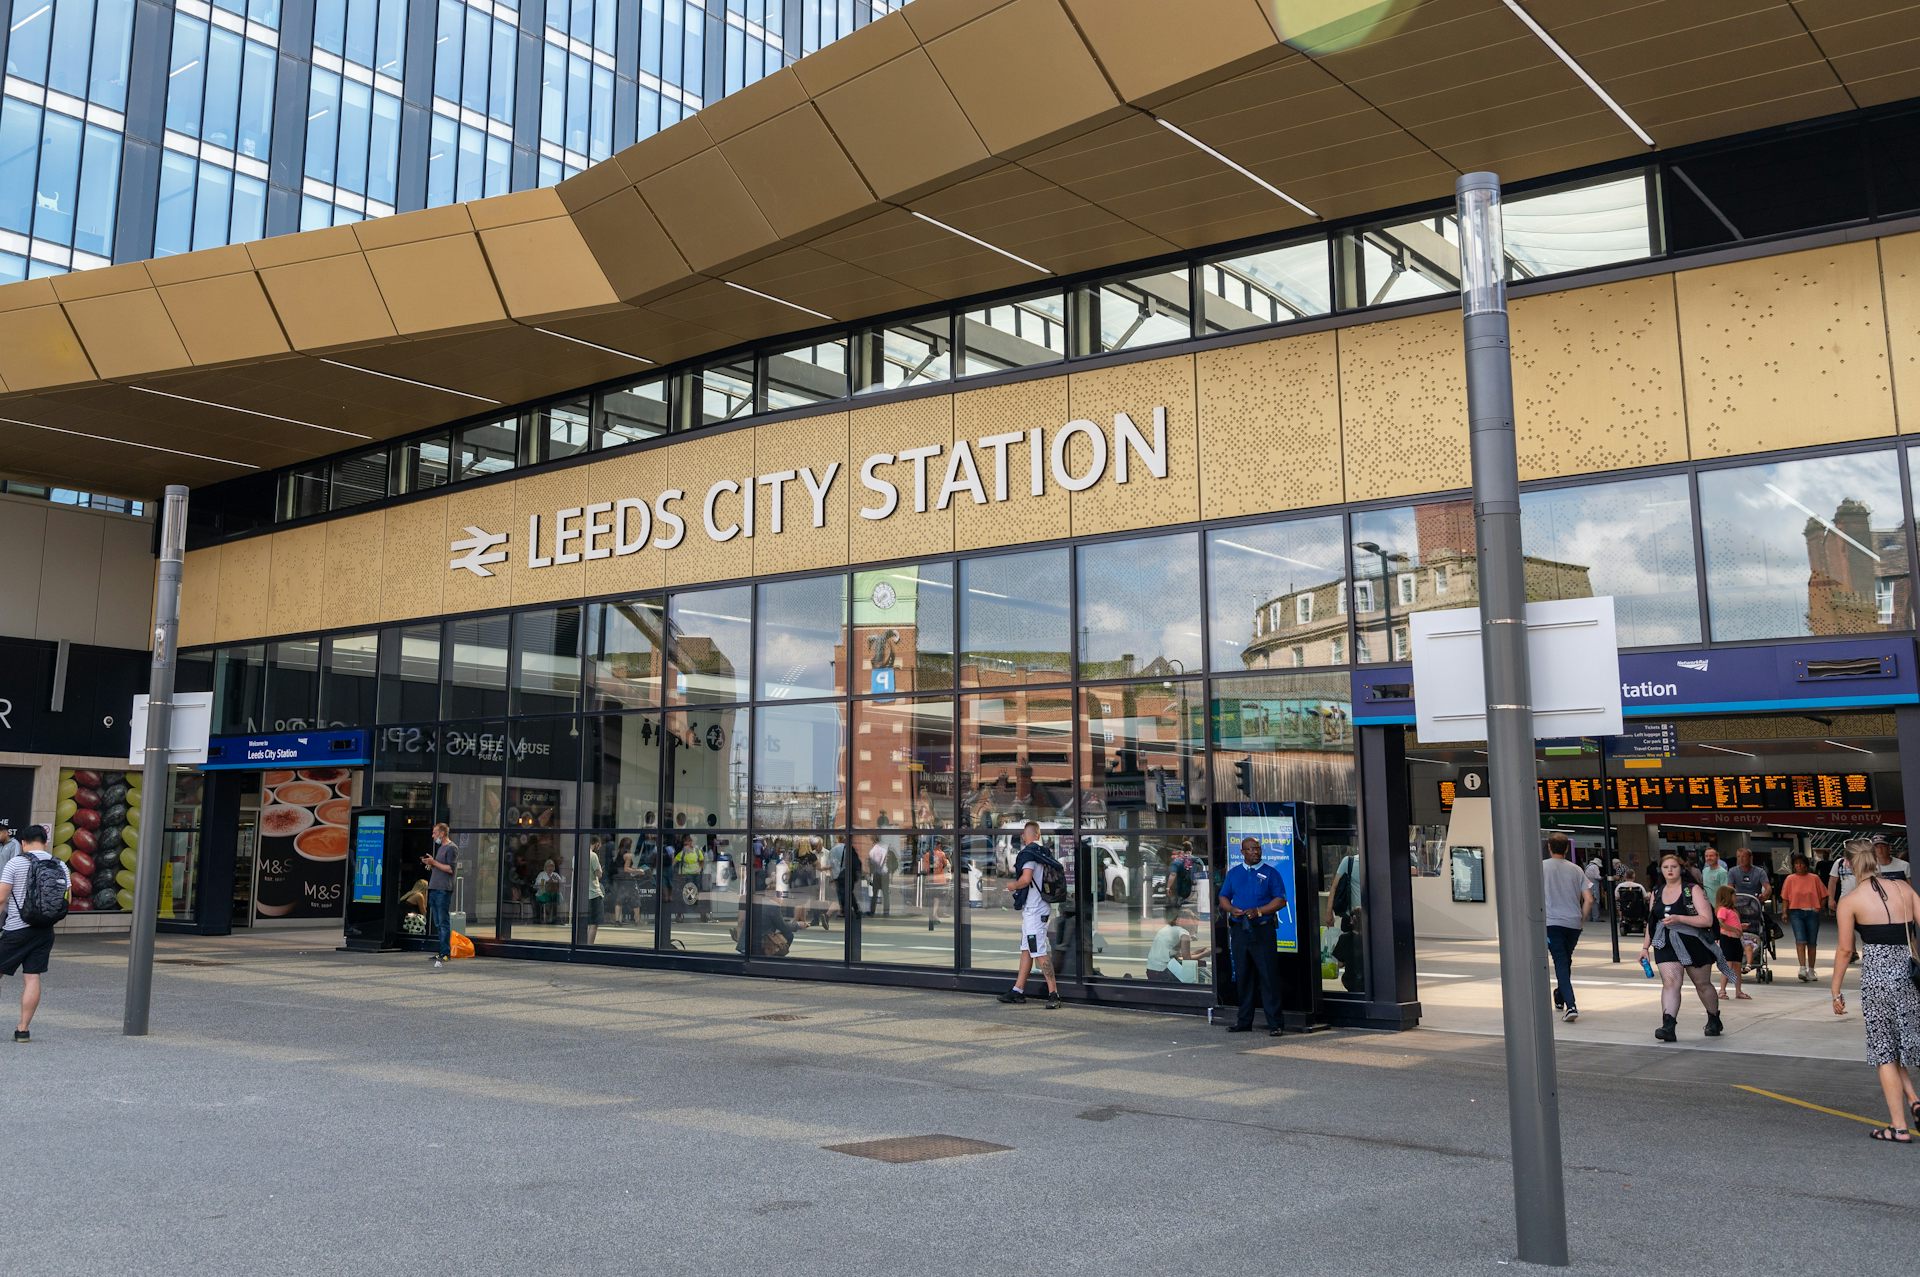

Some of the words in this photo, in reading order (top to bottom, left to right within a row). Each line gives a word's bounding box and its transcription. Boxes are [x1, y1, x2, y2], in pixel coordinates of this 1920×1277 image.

[527, 489, 686, 569] LEEDS
[703, 462, 842, 543] CITY
[859, 405, 1169, 521] STATION
[1622, 681, 1678, 698] tation
[247, 750, 264, 760] Leeds
[264, 749, 276, 761] City
[276, 748, 298, 759] Station
[1715, 814, 1730, 823] No
[1733, 814, 1763, 824] entry
[1831, 812, 1847, 822] No
[1851, 813, 1882, 823] entry
[1262, 836, 1292, 847] journey
[259, 858, 293, 874] M&S
[304, 880, 341, 900] M&S
